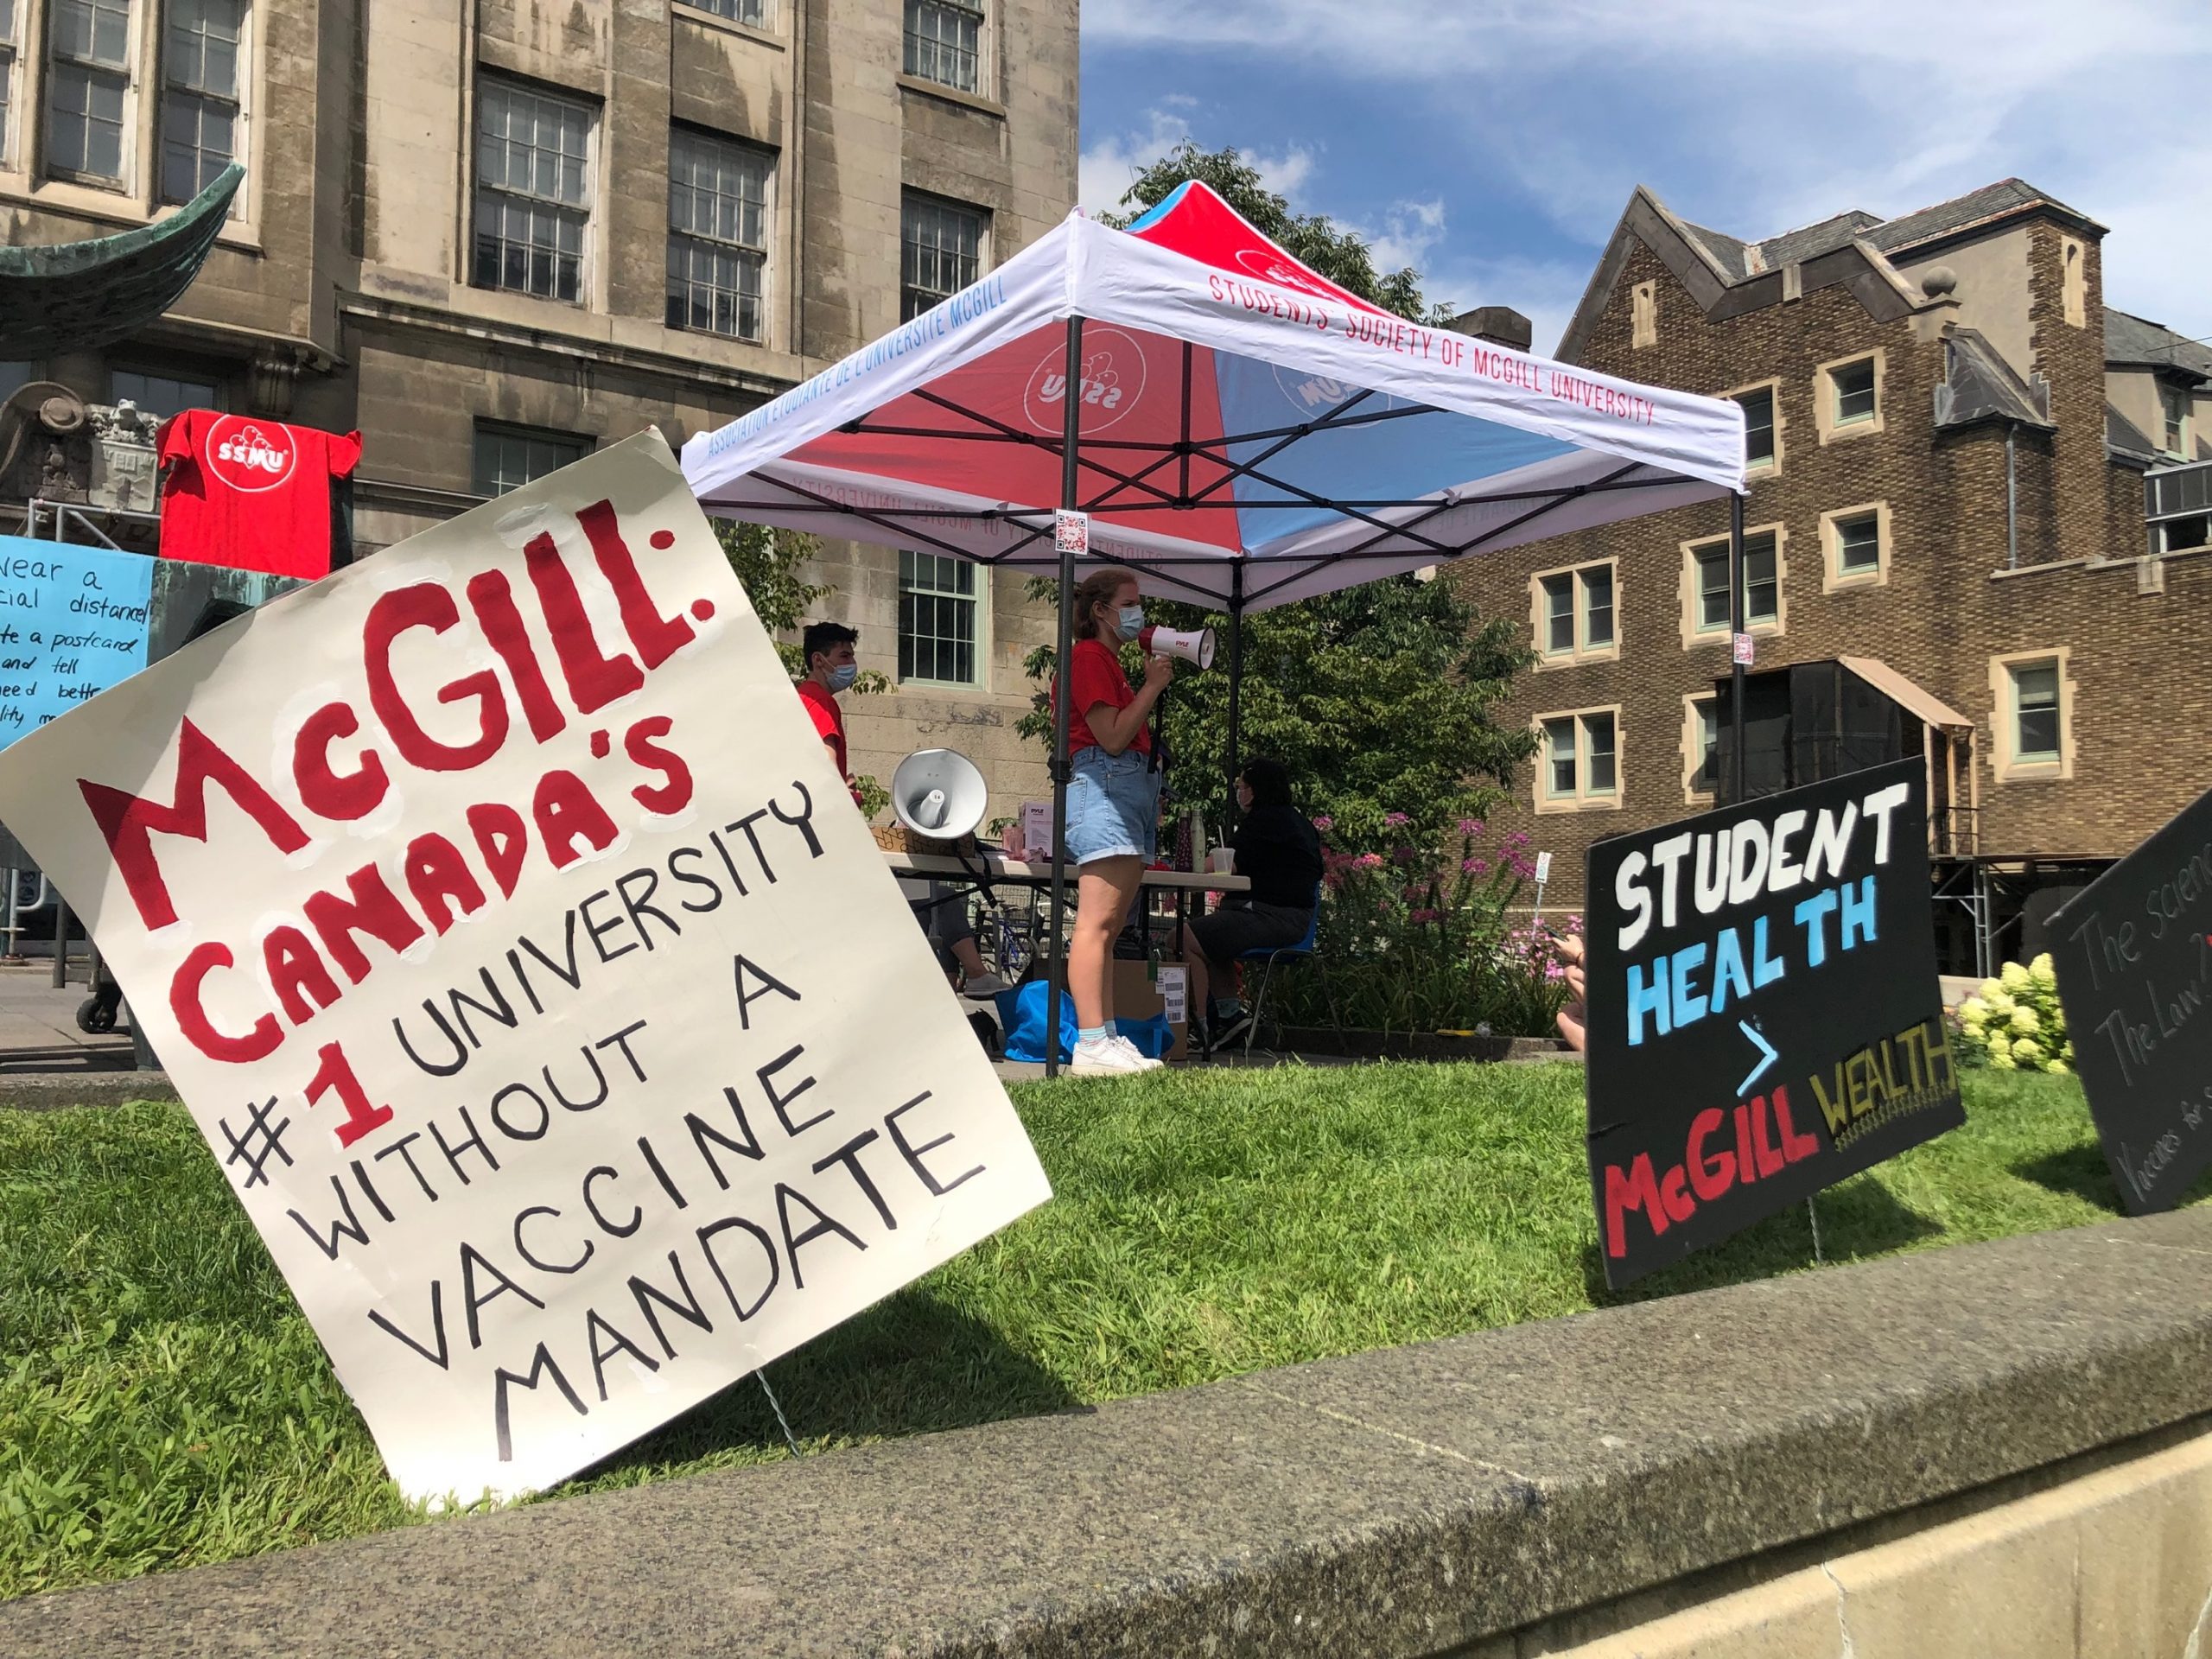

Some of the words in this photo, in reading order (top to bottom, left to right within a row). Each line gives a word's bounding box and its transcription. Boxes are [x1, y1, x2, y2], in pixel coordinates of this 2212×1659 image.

[709, 405, 770, 458] ASSOCIATION
[836, 359, 851, 387] DE
[950, 275, 1007, 330] MCGILL
[1345, 313, 1433, 359] SOCIETY
[1441, 338, 1465, 367] OF
[1474, 347, 1541, 392] MCGILL
[1552, 371, 1655, 426] UNIVERSITY
[218, 442, 284, 474] SSMU
[70, 593, 150, 632] distance!
[83, 571, 103, 590] a
[2, 657, 37, 670] and
[51, 656, 79, 675] tell
[29, 632, 42, 645] a
[51, 632, 139, 654] postcard
[169, 715, 693, 1064] CANADA'S
[1615, 782, 1910, 951] STUDENT
[391, 780, 824, 1077] UNIVERSITY
[1627, 874, 1878, 1046] HEALTH
[2068, 910, 2142, 991] The
[286, 1020, 647, 1261] WITHOUT
[734, 953, 801, 1030] A
[1809, 1014, 1958, 1136] WEALTH
[2094, 1008, 2158, 1087] The
[367, 1044, 836, 1370] VACCINE
[494, 1090, 986, 1462] MANDATE
